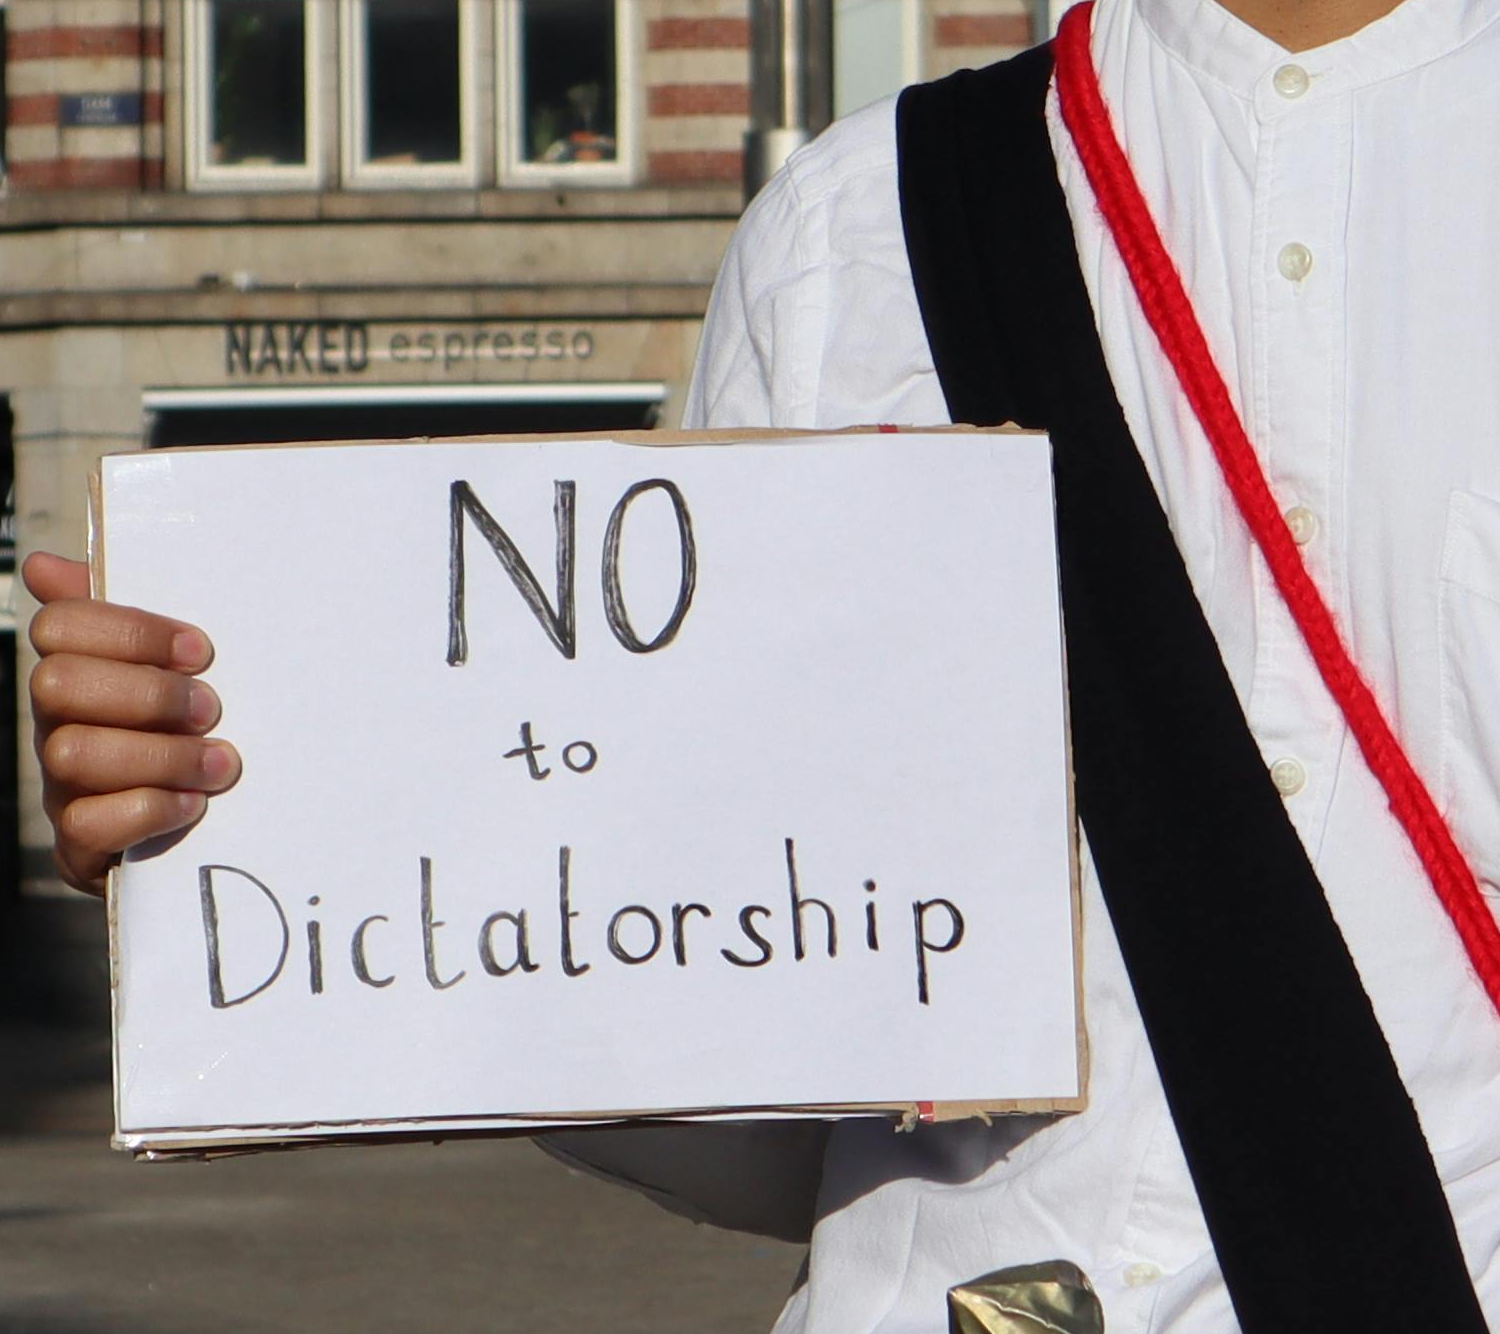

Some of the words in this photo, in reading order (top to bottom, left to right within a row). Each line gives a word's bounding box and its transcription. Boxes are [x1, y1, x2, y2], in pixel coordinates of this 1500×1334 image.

[225, 322, 369, 376] NAKED
[388, 329, 595, 369] espresso
[445, 477, 697, 667] NO
[503, 721, 598, 781] to
[198, 836, 966, 1009] Dictatorship
